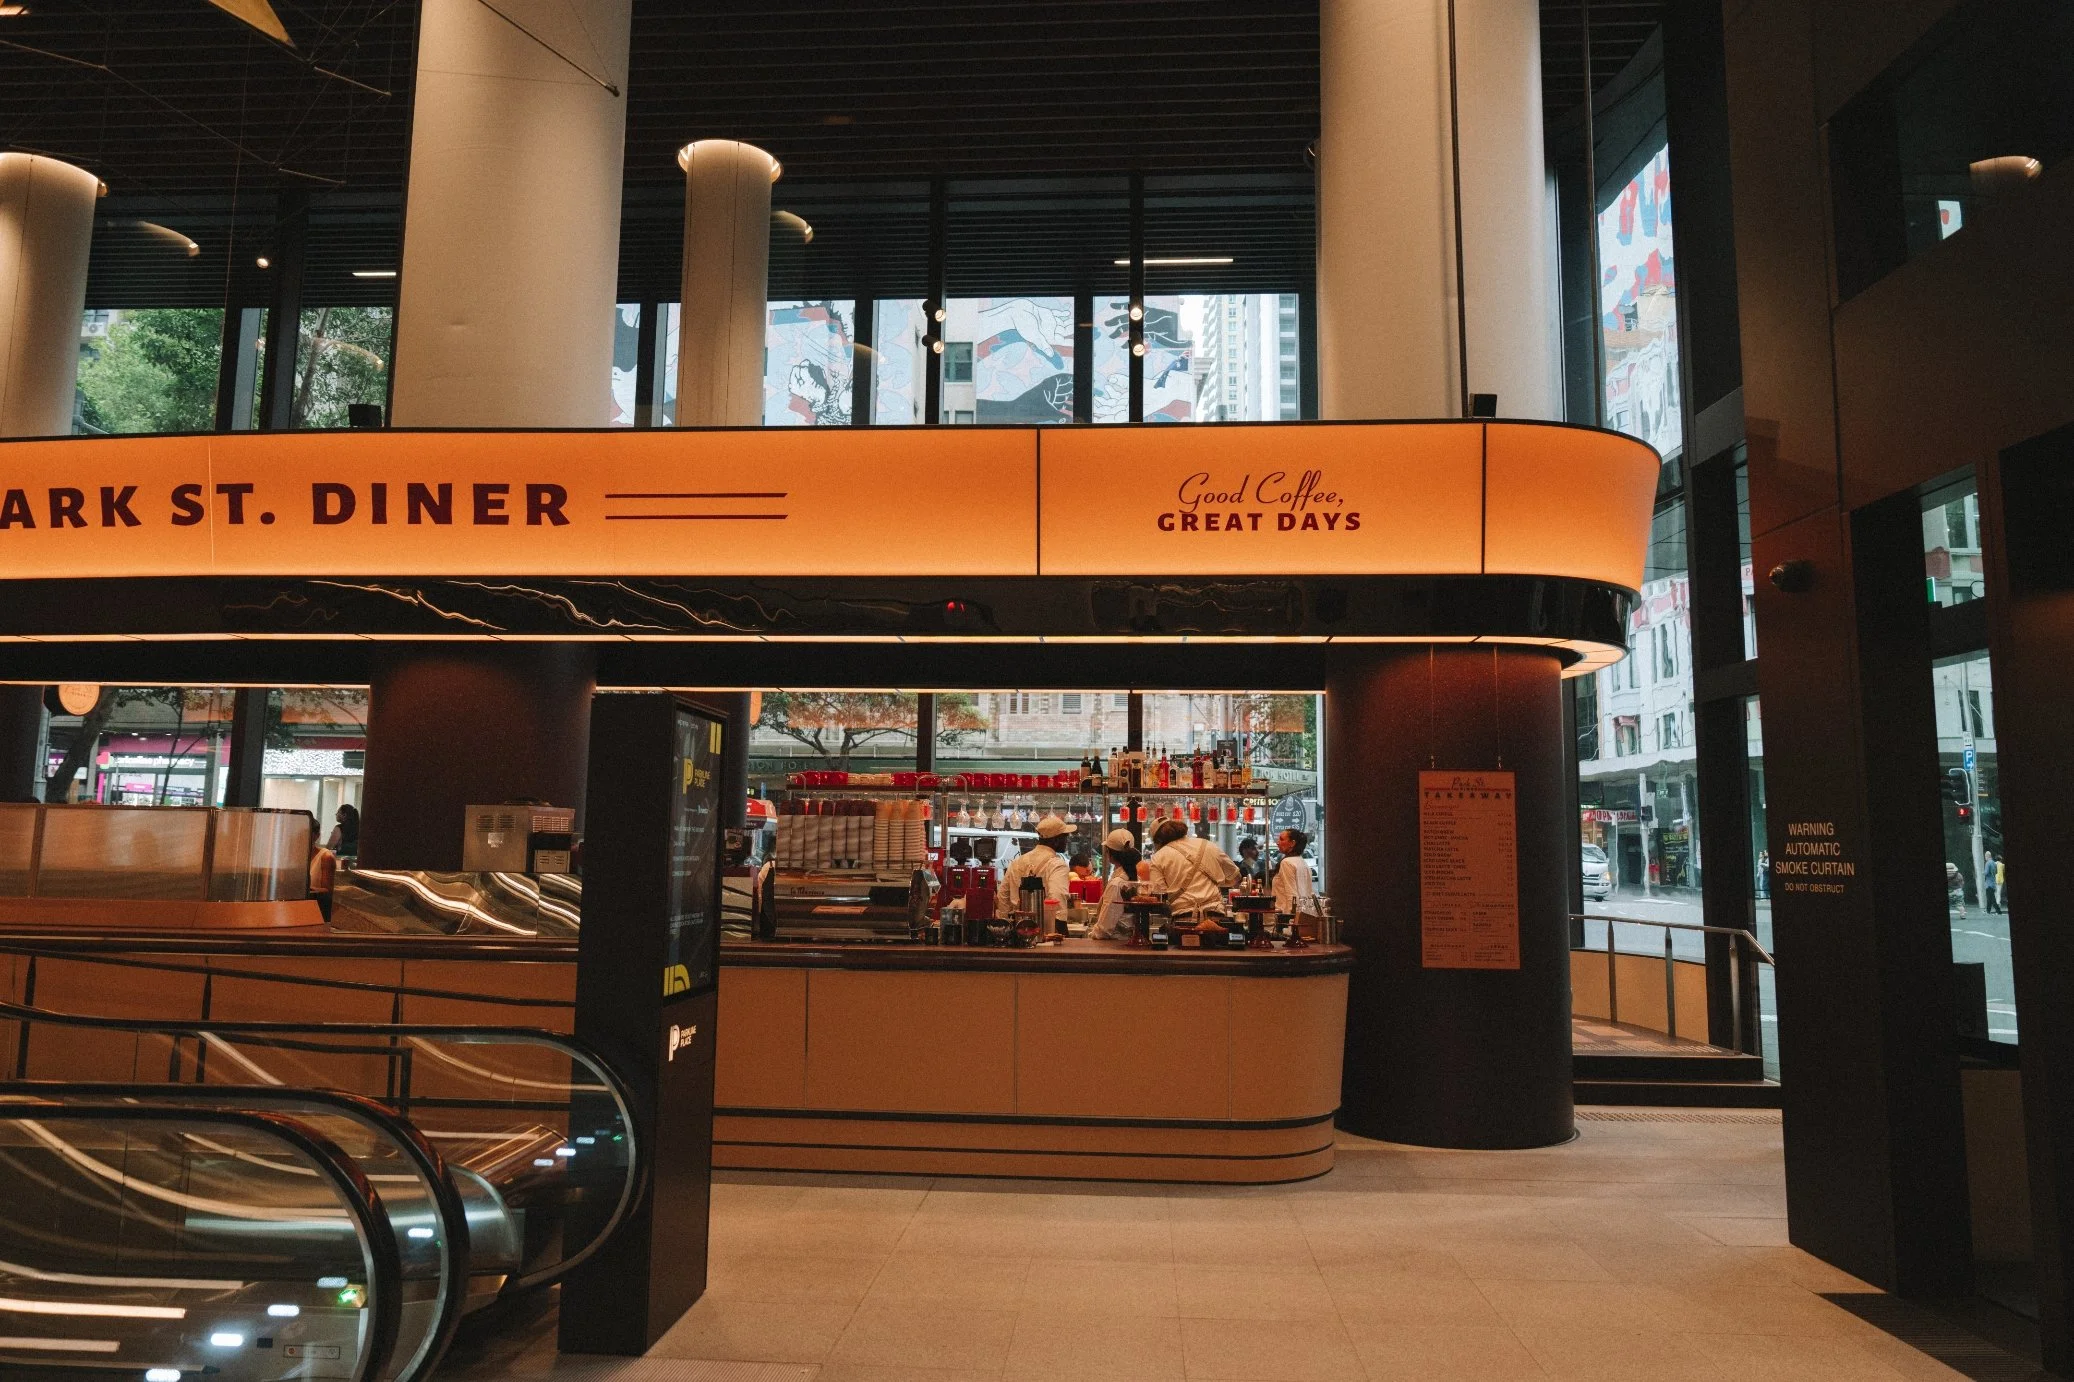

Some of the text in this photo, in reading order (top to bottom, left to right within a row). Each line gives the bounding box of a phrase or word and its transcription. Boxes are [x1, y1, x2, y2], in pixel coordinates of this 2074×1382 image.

[1179, 470, 1344, 512] Good Coffee,
[171, 483, 275, 526] ST.
[312, 482, 570, 526] DINER
[1157, 512, 1361, 532] GREAT DAYS
[1424, 791, 1512, 800] TAKEAWAY
[1788, 822, 1835, 836] WARNING
[1785, 842, 1841, 856] AUTOMATIC
[1775, 861, 1855, 876] SMOKE CURTAIN
[1784, 882, 1845, 894] DO NOT OBSTRUCT
